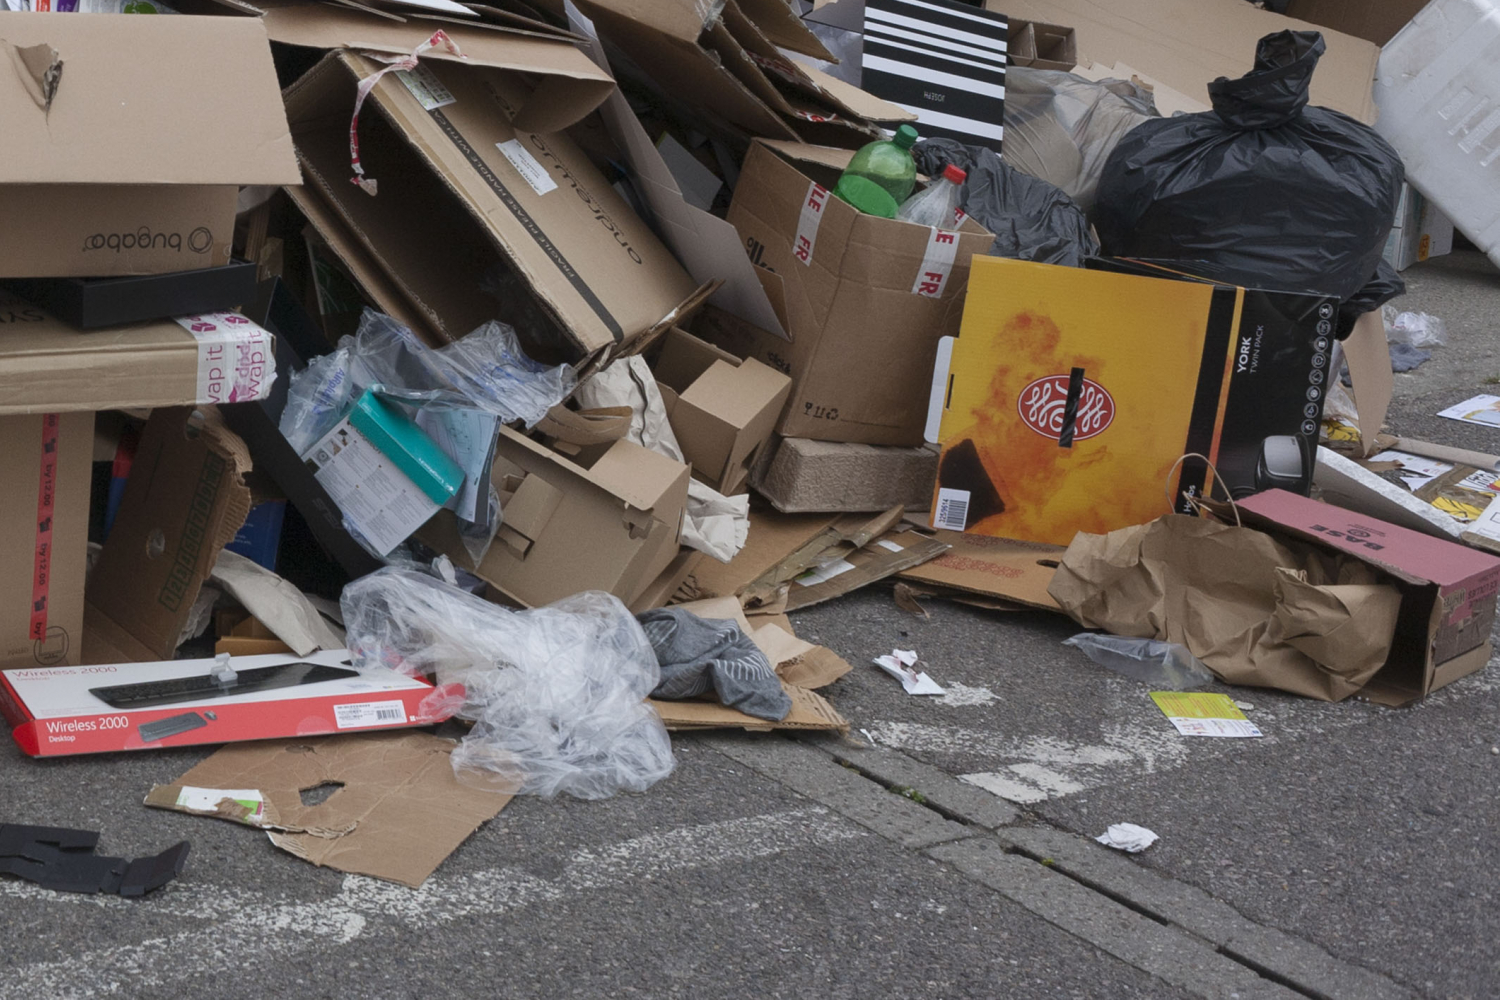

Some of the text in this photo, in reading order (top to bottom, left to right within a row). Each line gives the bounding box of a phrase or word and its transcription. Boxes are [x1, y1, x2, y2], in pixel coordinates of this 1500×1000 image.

[923, 89, 946, 103] JOSEPH
[82, 226, 182, 253] bugaboo
[249, 329, 263, 349] it
[1248, 324, 1264, 375] TWIN PACK
[208, 344, 223, 363] it
[1236, 336, 1253, 374] YORK
[43, 479, 52, 507] 12.00
[1309, 523, 1385, 551] BASE
[38, 560, 48, 586] 12.00
[13, 665, 118, 679] Wireless 2000
[46, 715, 129, 733] Wireless 2000
[48, 733, 76, 744] Desktop
